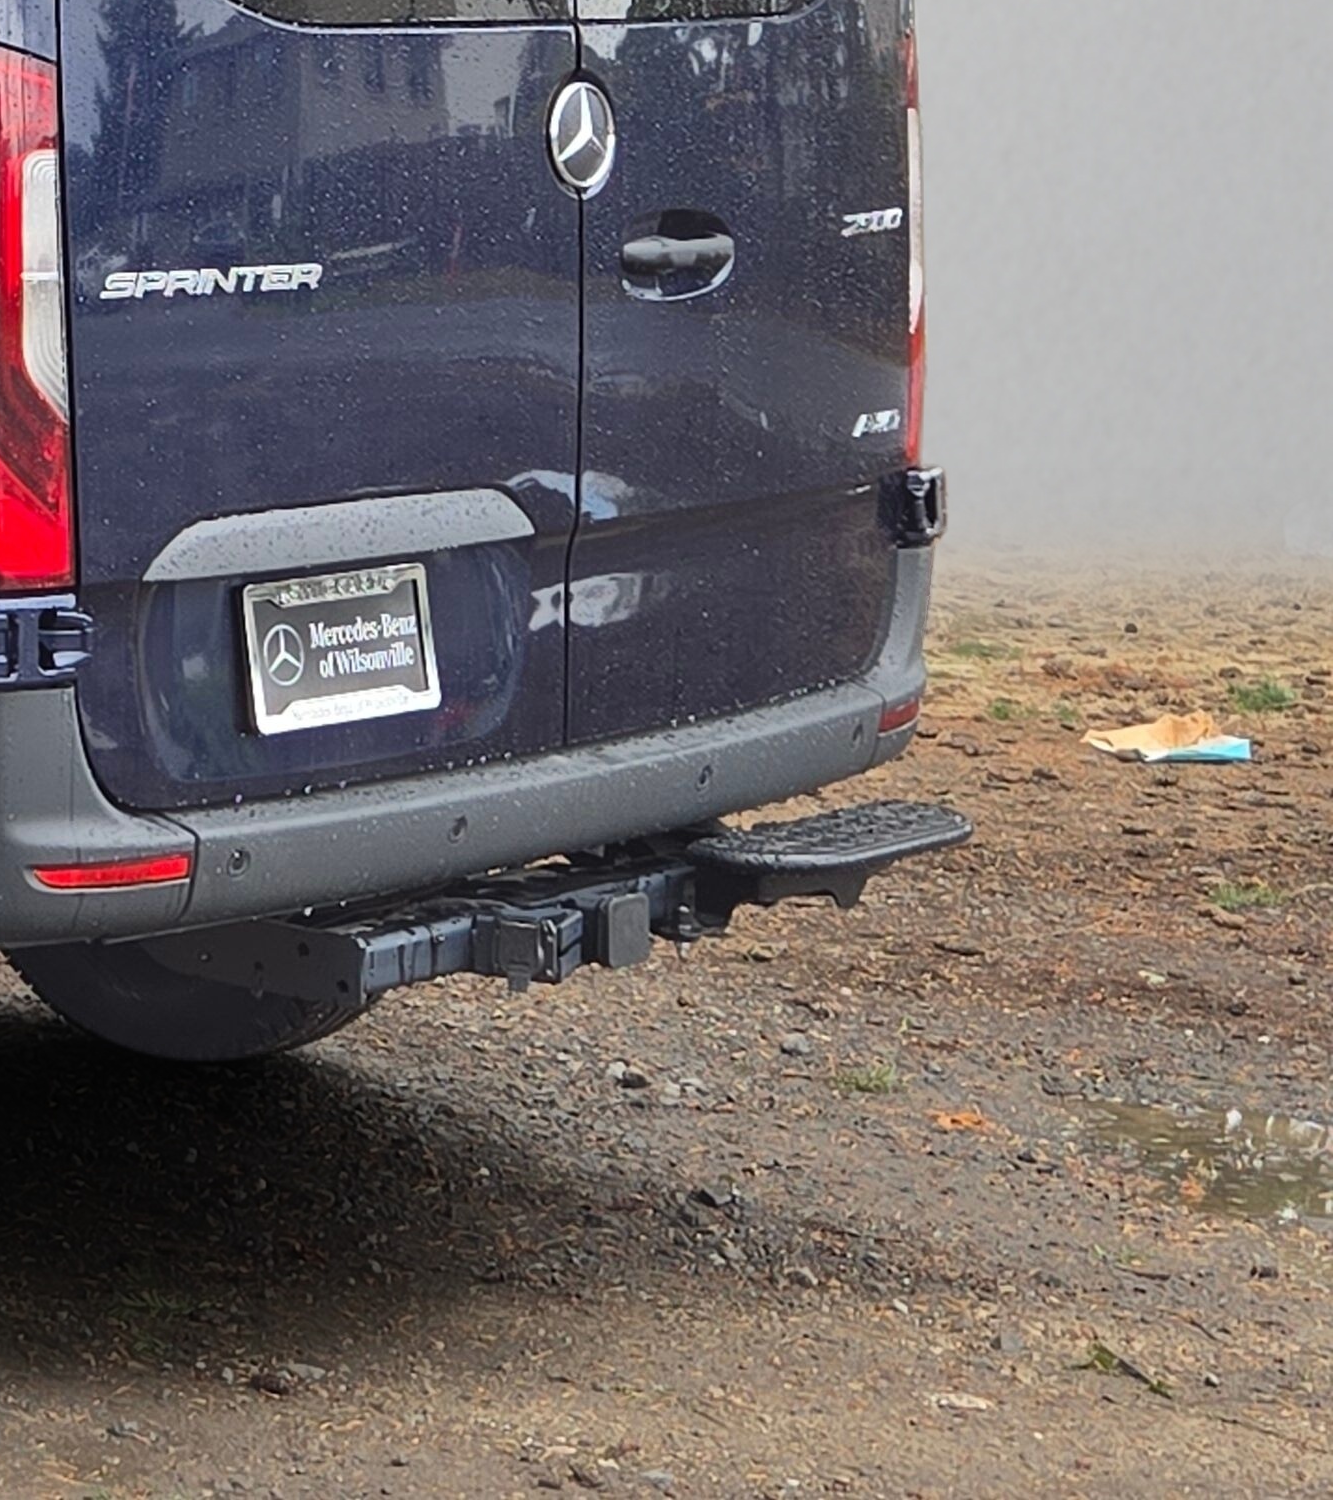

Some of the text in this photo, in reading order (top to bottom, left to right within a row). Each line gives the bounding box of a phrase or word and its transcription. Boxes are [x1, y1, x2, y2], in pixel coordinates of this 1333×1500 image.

[99, 263, 323, 300] SPRINTER
[308, 612, 418, 649] Mercedes-Benz
[319, 641, 415, 679] of Wilsonville
